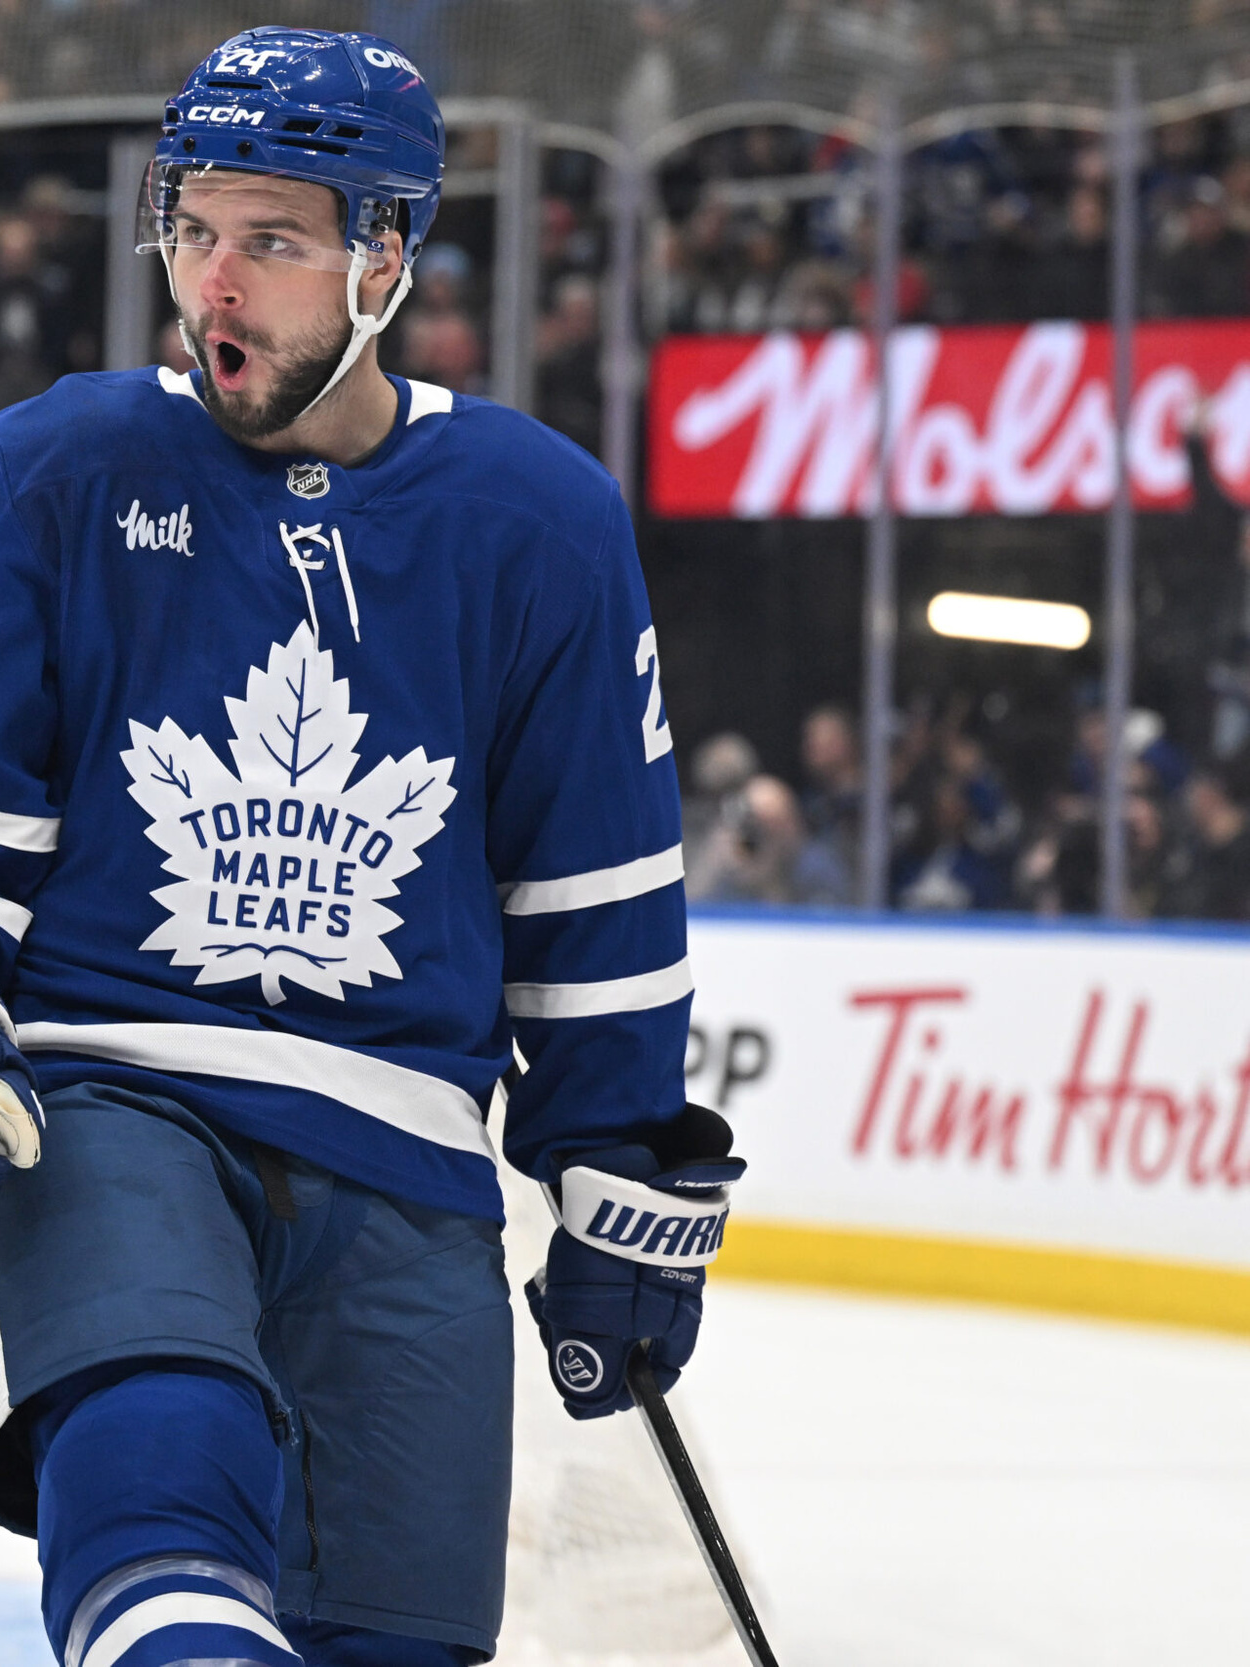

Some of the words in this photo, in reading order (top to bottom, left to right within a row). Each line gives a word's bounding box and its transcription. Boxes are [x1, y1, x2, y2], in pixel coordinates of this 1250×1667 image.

[212, 48, 287, 76] 24
[187, 105, 266, 126] CCM
[296, 472, 321, 491] NHL
[115, 498, 196, 558] Milk
[179, 797, 393, 870] TORONTO
[211, 847, 357, 897] MAPLE
[207, 890, 352, 938] LEAFS
[846, 986, 1023, 1174] Tim
[660, 1267, 698, 1285] COVERT
